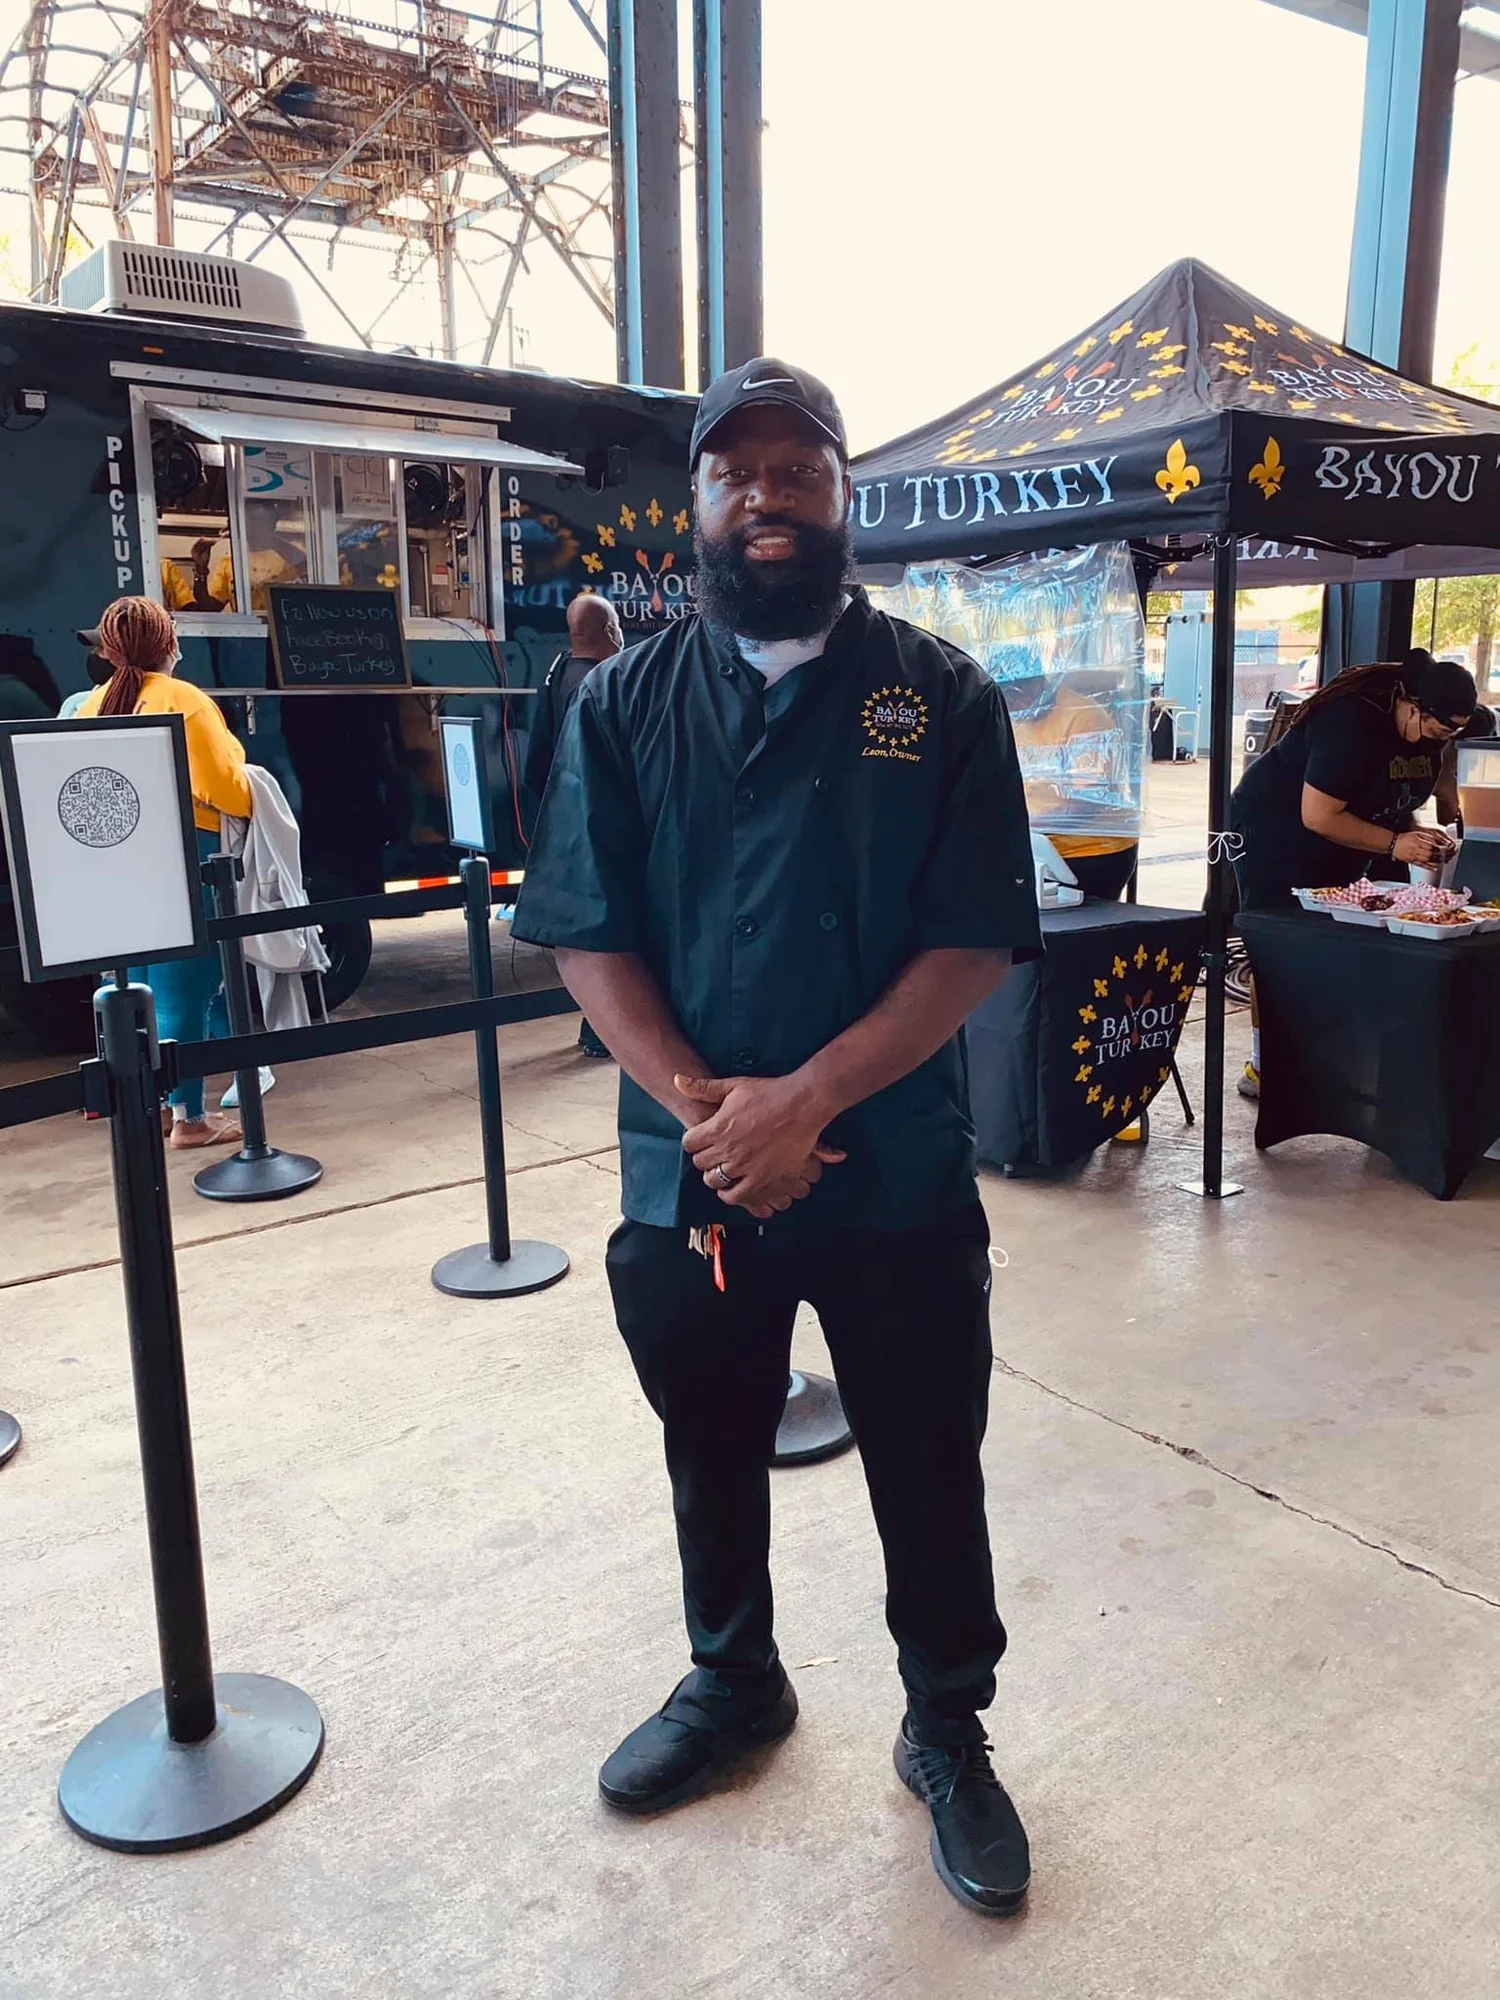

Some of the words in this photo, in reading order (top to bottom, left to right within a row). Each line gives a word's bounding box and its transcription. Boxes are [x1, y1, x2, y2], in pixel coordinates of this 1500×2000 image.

[1009, 373, 1140, 409] BAYOU
[1286, 387, 1416, 404] TURKEY
[981, 397, 1120, 428] TURKEY
[903, 455, 1118, 530] TURKEY
[1315, 446, 1481, 502] BAYOU
[106, 436, 132, 588] PICKUP
[508, 476, 523, 586] ORDER
[873, 714, 918, 727] TURKEY
[876, 702, 917, 718] BAYOU
[1101, 999, 1175, 1040] BAYOU
[1095, 1028, 1175, 1065] TURKEY
